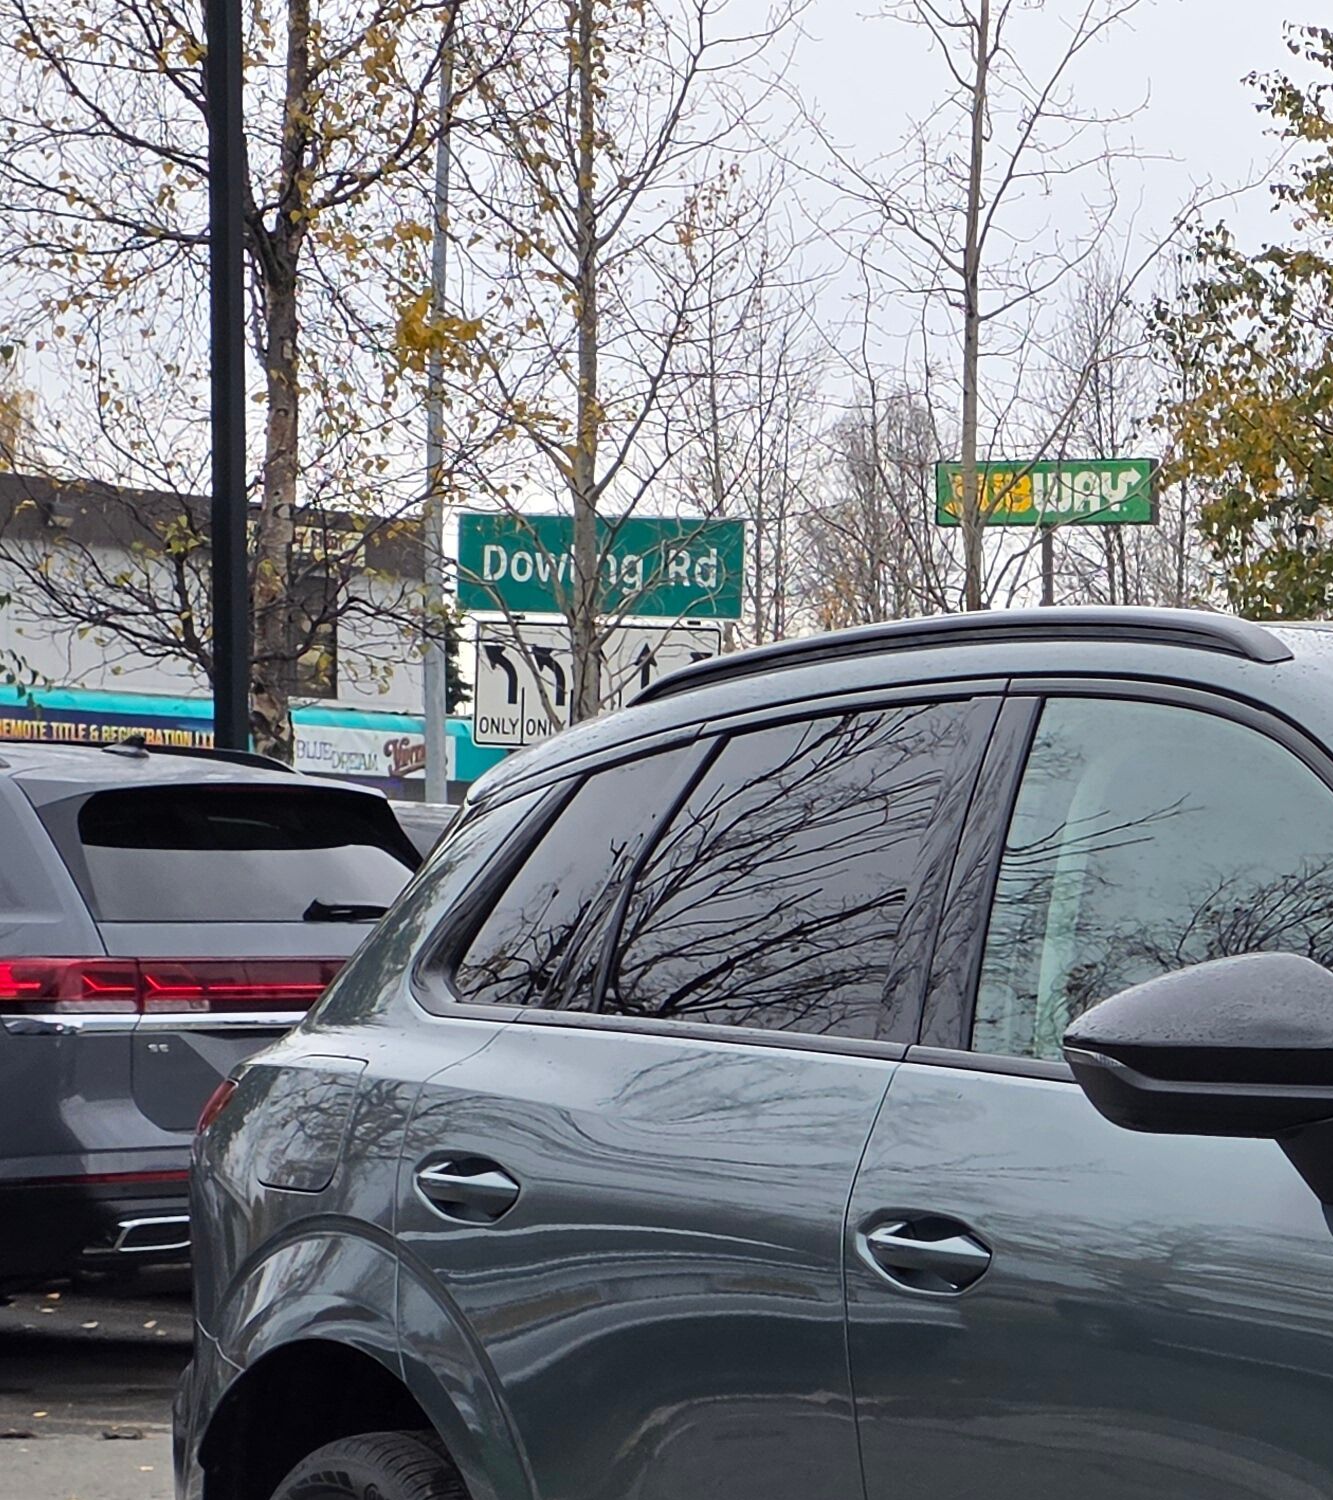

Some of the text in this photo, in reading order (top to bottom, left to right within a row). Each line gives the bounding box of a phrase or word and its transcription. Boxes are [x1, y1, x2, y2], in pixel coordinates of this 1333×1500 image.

[484, 544, 718, 596] Dowlng Rd
[50, 721, 87, 742] TITLE
[90, 724, 99, 743] &
[479, 716, 519, 735] ONLY
[296, 740, 332, 760] BLUE
